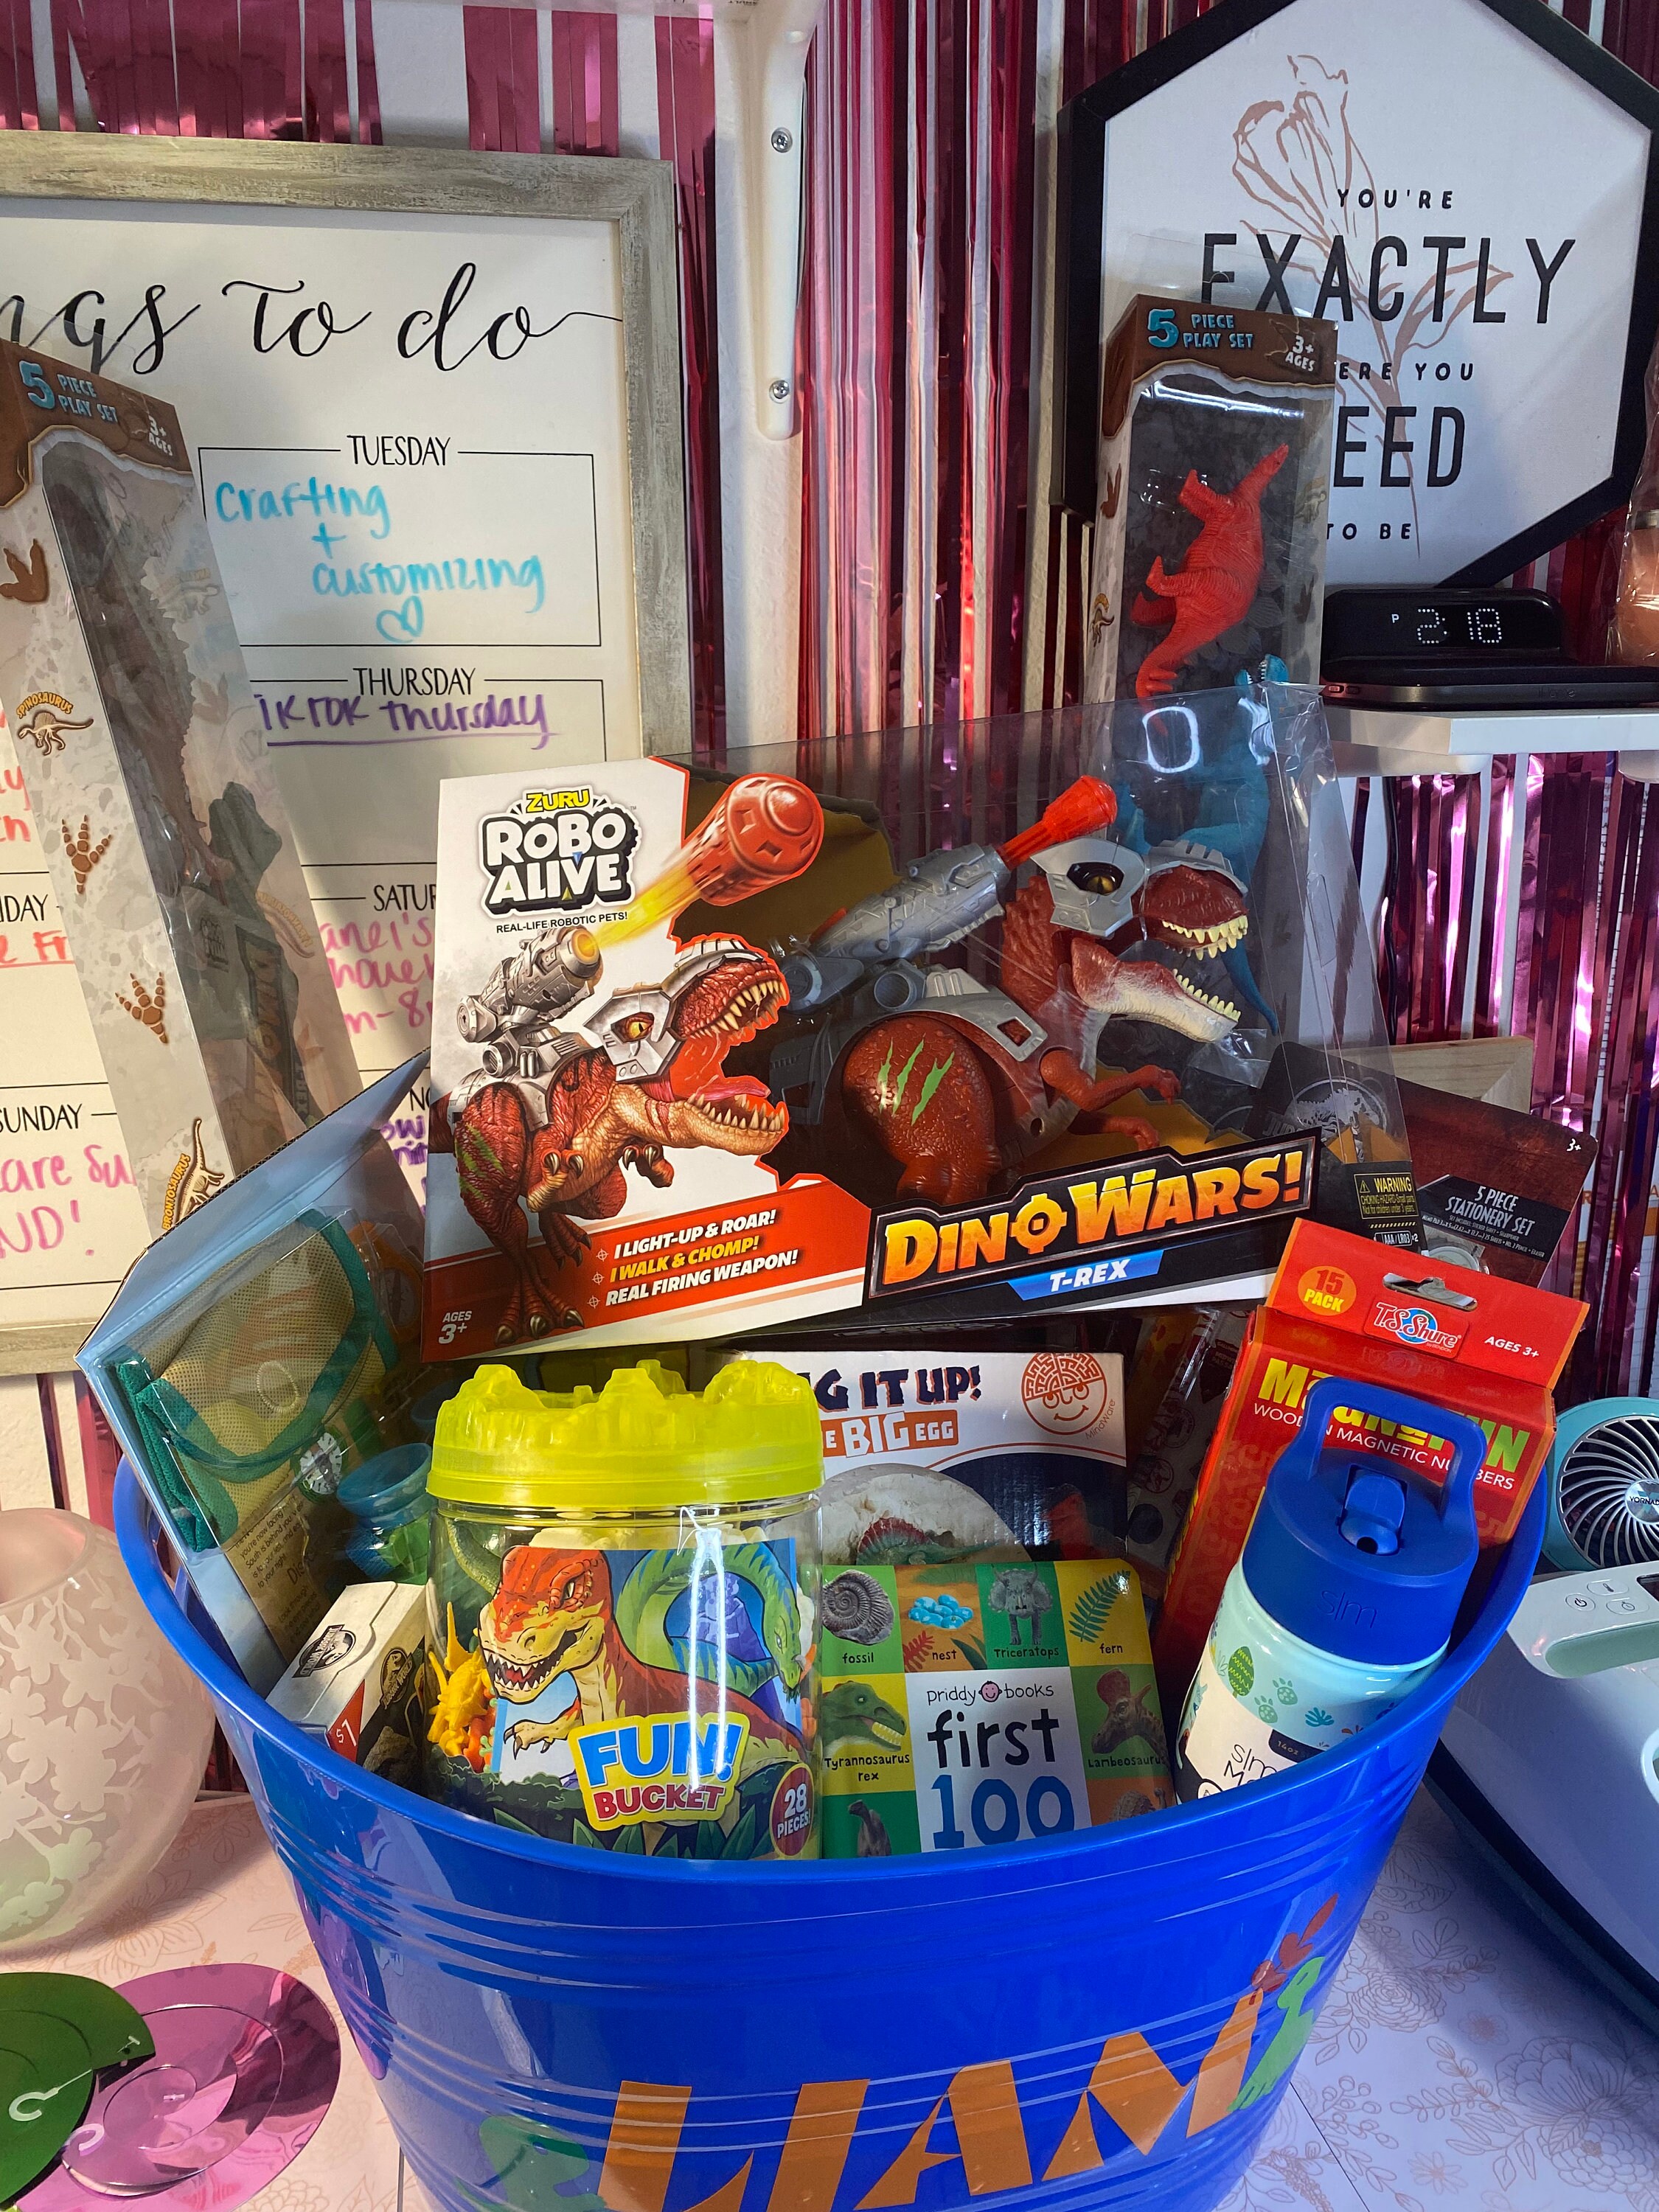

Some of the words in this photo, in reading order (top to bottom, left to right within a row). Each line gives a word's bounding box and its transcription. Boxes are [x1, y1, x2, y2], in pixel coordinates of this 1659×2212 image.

[1337, 188, 1453, 209] YOU'RE
[1200, 232, 1576, 324] EXACTLY
[397, 262, 623, 372] do
[1147, 308, 1179, 348] 5
[1191, 313, 1234, 329] PIECE
[1183, 333, 1221, 349] PLAY
[1229, 333, 1254, 349] SET
[1292, 335, 1314, 354] 3+
[1285, 352, 1316, 372] AGES
[1338, 362, 1392, 380] ERE
[1416, 363, 1474, 381] YOU
[18, 360, 56, 410] 5
[57, 373, 97, 399] PIECE
[58, 394, 92, 418] PLAY
[97, 403, 118, 423] SET
[148, 414, 167, 437] 3+
[148, 434, 173, 456] AGES
[347, 435, 451, 467] TUESDAY
[1333, 406, 1466, 488] EED
[1380, 523, 1412, 540] BE
[1391, 613, 1399, 623] P
[1416, 608, 1503, 644] 2:18
[353, 667, 476, 697] THURSDAY
[16, 692, 74, 719] SPINOSAURUS
[526, 788, 591, 813] ZURU
[487, 852, 624, 906] ALIVE
[496, 919, 548, 934] REAL-LIFE
[550, 915, 597, 928] ROBOTIC
[599, 911, 628, 923] PETS!
[1566, 1138, 1582, 1152] 3+
[161, 1153, 192, 1231] BRONTOSAURUS
[1374, 1177, 1413, 1193] WARNING
[1475, 1185, 1486, 1201] 5
[1485, 1189, 1519, 1212] PIECE
[883, 1192, 1068, 1286] DINO
[1068, 1150, 1304, 1245] WARS!
[1445, 1196, 1513, 1229] STATIONERY
[1512, 1217, 1536, 1236] SET
[613, 1244, 622, 1259] I
[622, 1225, 704, 1258] LIGHT-UP
[705, 1222, 719, 1239] &
[720, 1208, 776, 1235] ROAR!
[610, 1267, 617, 1283] I
[619, 1255, 671, 1281] WALK
[671, 1252, 686, 1269] &
[688, 1235, 759, 1265] CHOMP!
[605, 1282, 650, 1307] REAL
[651, 1269, 711, 1297] FIRING
[713, 1249, 799, 1283] WEAPON!
[1049, 1258, 1131, 1293] T-REX
[1316, 1268, 1346, 1295] 15
[1304, 1287, 1344, 1313] PACK
[442, 1310, 472, 1323] AGES
[437, 1323, 467, 1345] 3+
[1484, 1335, 1521, 1354] AGES
[1522, 1345, 1540, 1358] 3+
[859, 1368, 909, 1409] IT
[915, 1365, 981, 1405] UP!
[1085, 1399, 1116, 1440] MindWare
[841, 1411, 910, 1458] BIG
[915, 1420, 954, 1441] EGG
[1337, 1427, 1427, 1464] MAGNETIC
[842, 1652, 874, 1664] fossil
[932, 1649, 956, 1660] nest
[993, 1646, 1060, 1659] Triceratops
[1099, 1643, 1124, 1654] fern
[927, 1684, 977, 1706] priddy
[1004, 1683, 1054, 1699] books
[335, 1719, 357, 1747] $1
[927, 1708, 1060, 1769] first
[578, 1719, 743, 1787] FUN!
[824, 1753, 910, 1770] Tyrannosaurus
[1088, 1754, 1166, 1768] Lambeosaurus
[858, 1771, 879, 1781] rex
[593, 1784, 726, 1820] BUCKET
[783, 1782, 807, 1818] 28
[931, 1774, 1075, 1850] 100
[776, 1811, 811, 1839] PIECES!
[597, 1988, 1265, 2212] LIAM
